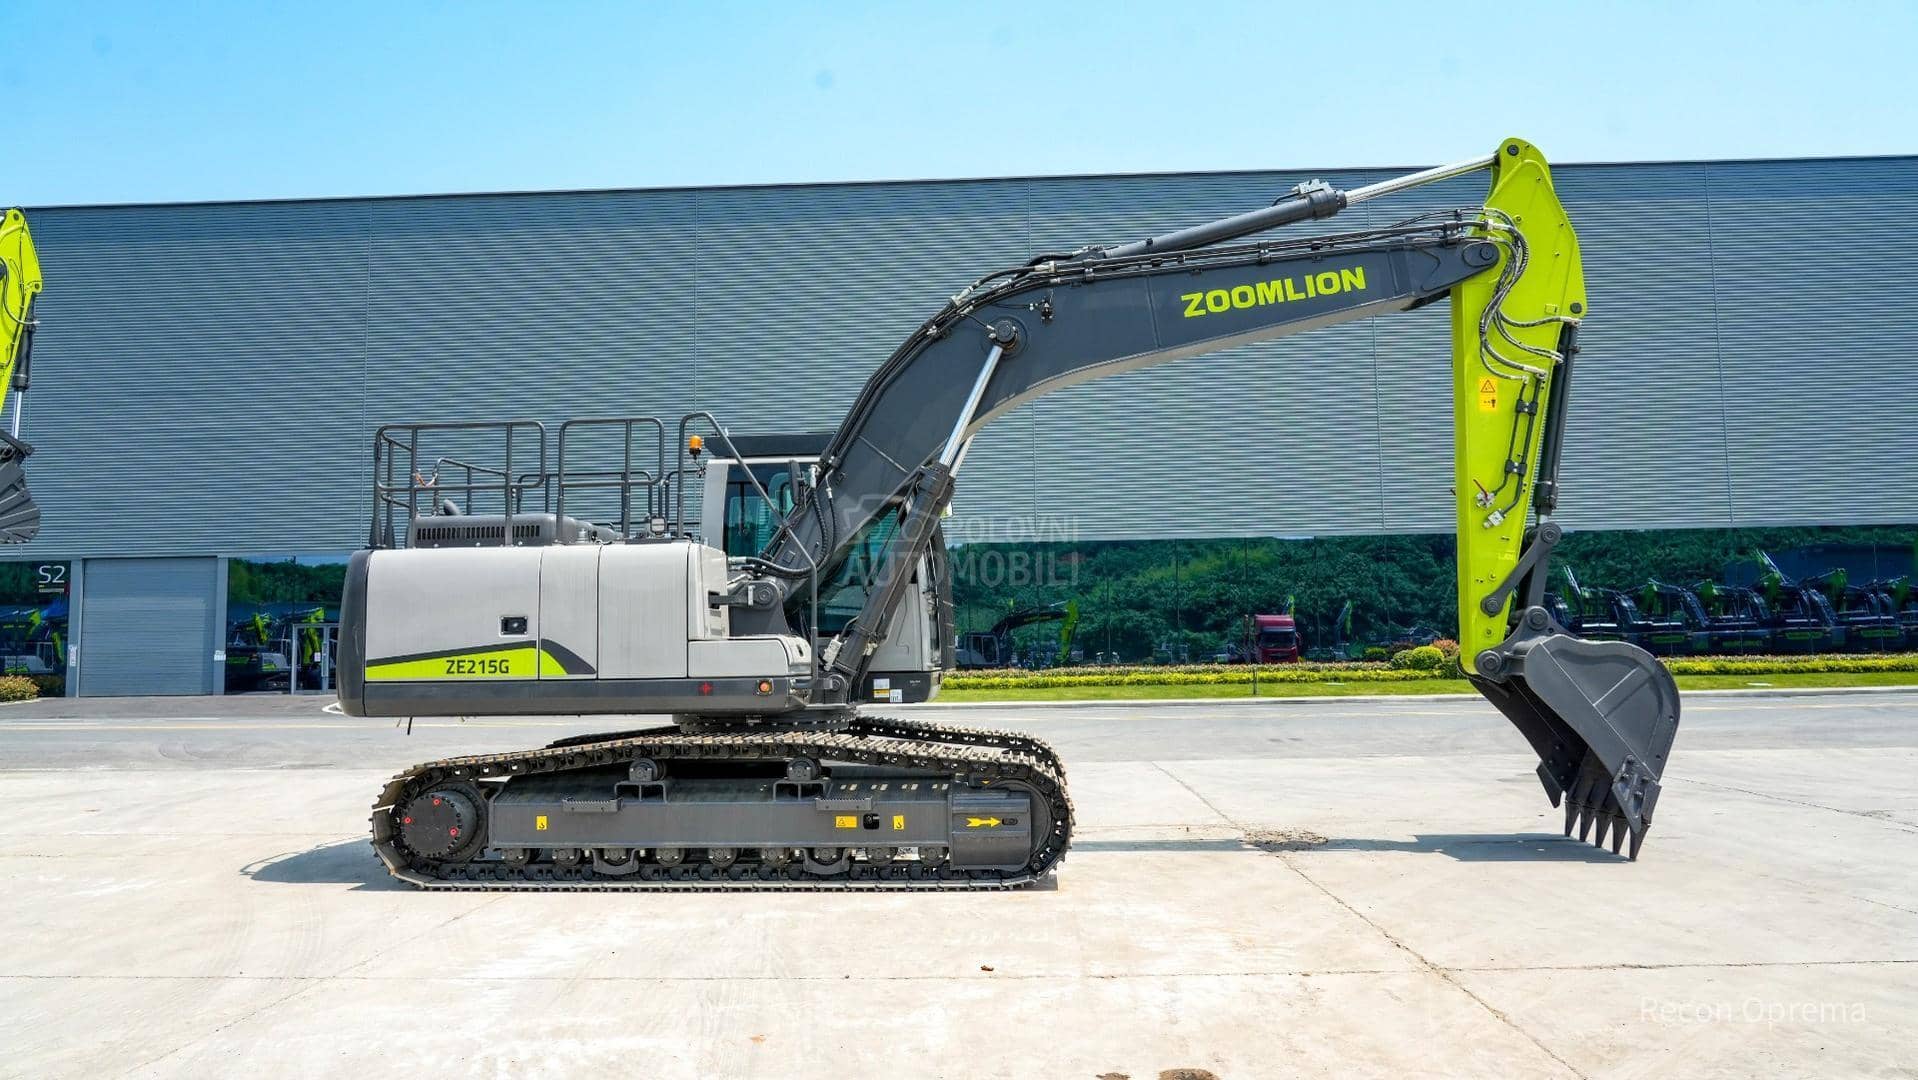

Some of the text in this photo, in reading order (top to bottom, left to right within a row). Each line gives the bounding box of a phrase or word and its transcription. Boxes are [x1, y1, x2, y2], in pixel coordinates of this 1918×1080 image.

[1181, 266, 1366, 318] ZOOMLION
[38, 565, 65, 583] S2
[446, 659, 509, 674] ZE215G
